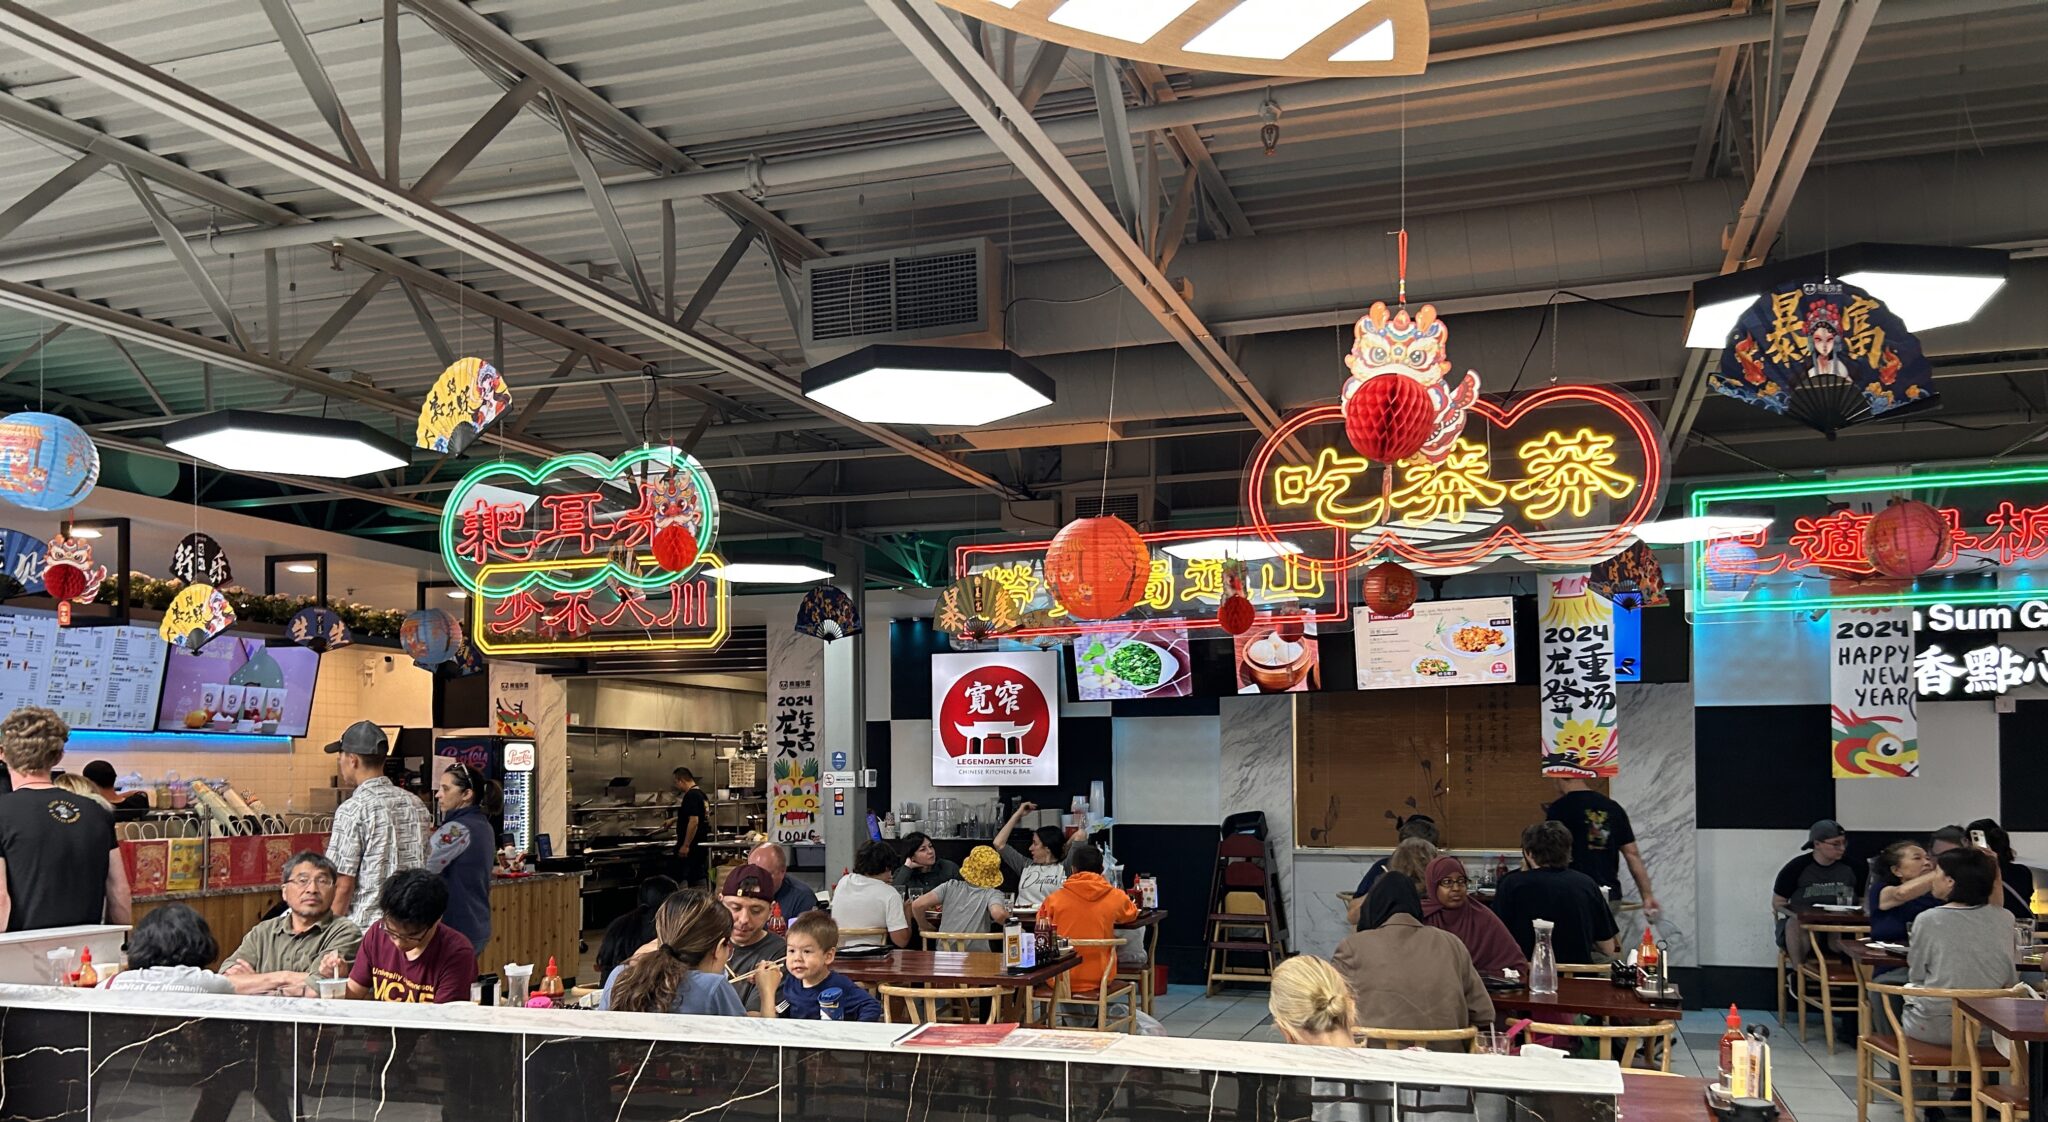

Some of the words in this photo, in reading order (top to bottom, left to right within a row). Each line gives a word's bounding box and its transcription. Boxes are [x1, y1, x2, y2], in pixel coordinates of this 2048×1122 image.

[1928, 603, 2012, 631] Sum
[1544, 624, 1609, 643] 2024
[1836, 620, 1909, 639] 2024
[1838, 645, 1910, 666] HAPPY
[1862, 666, 1909, 685] NEW
[777, 695, 813, 707] 2024
[964, 680, 1024, 715] 寬窄
[1542, 677, 1616, 714] 登场
[1854, 687, 1909, 707] YEAR
